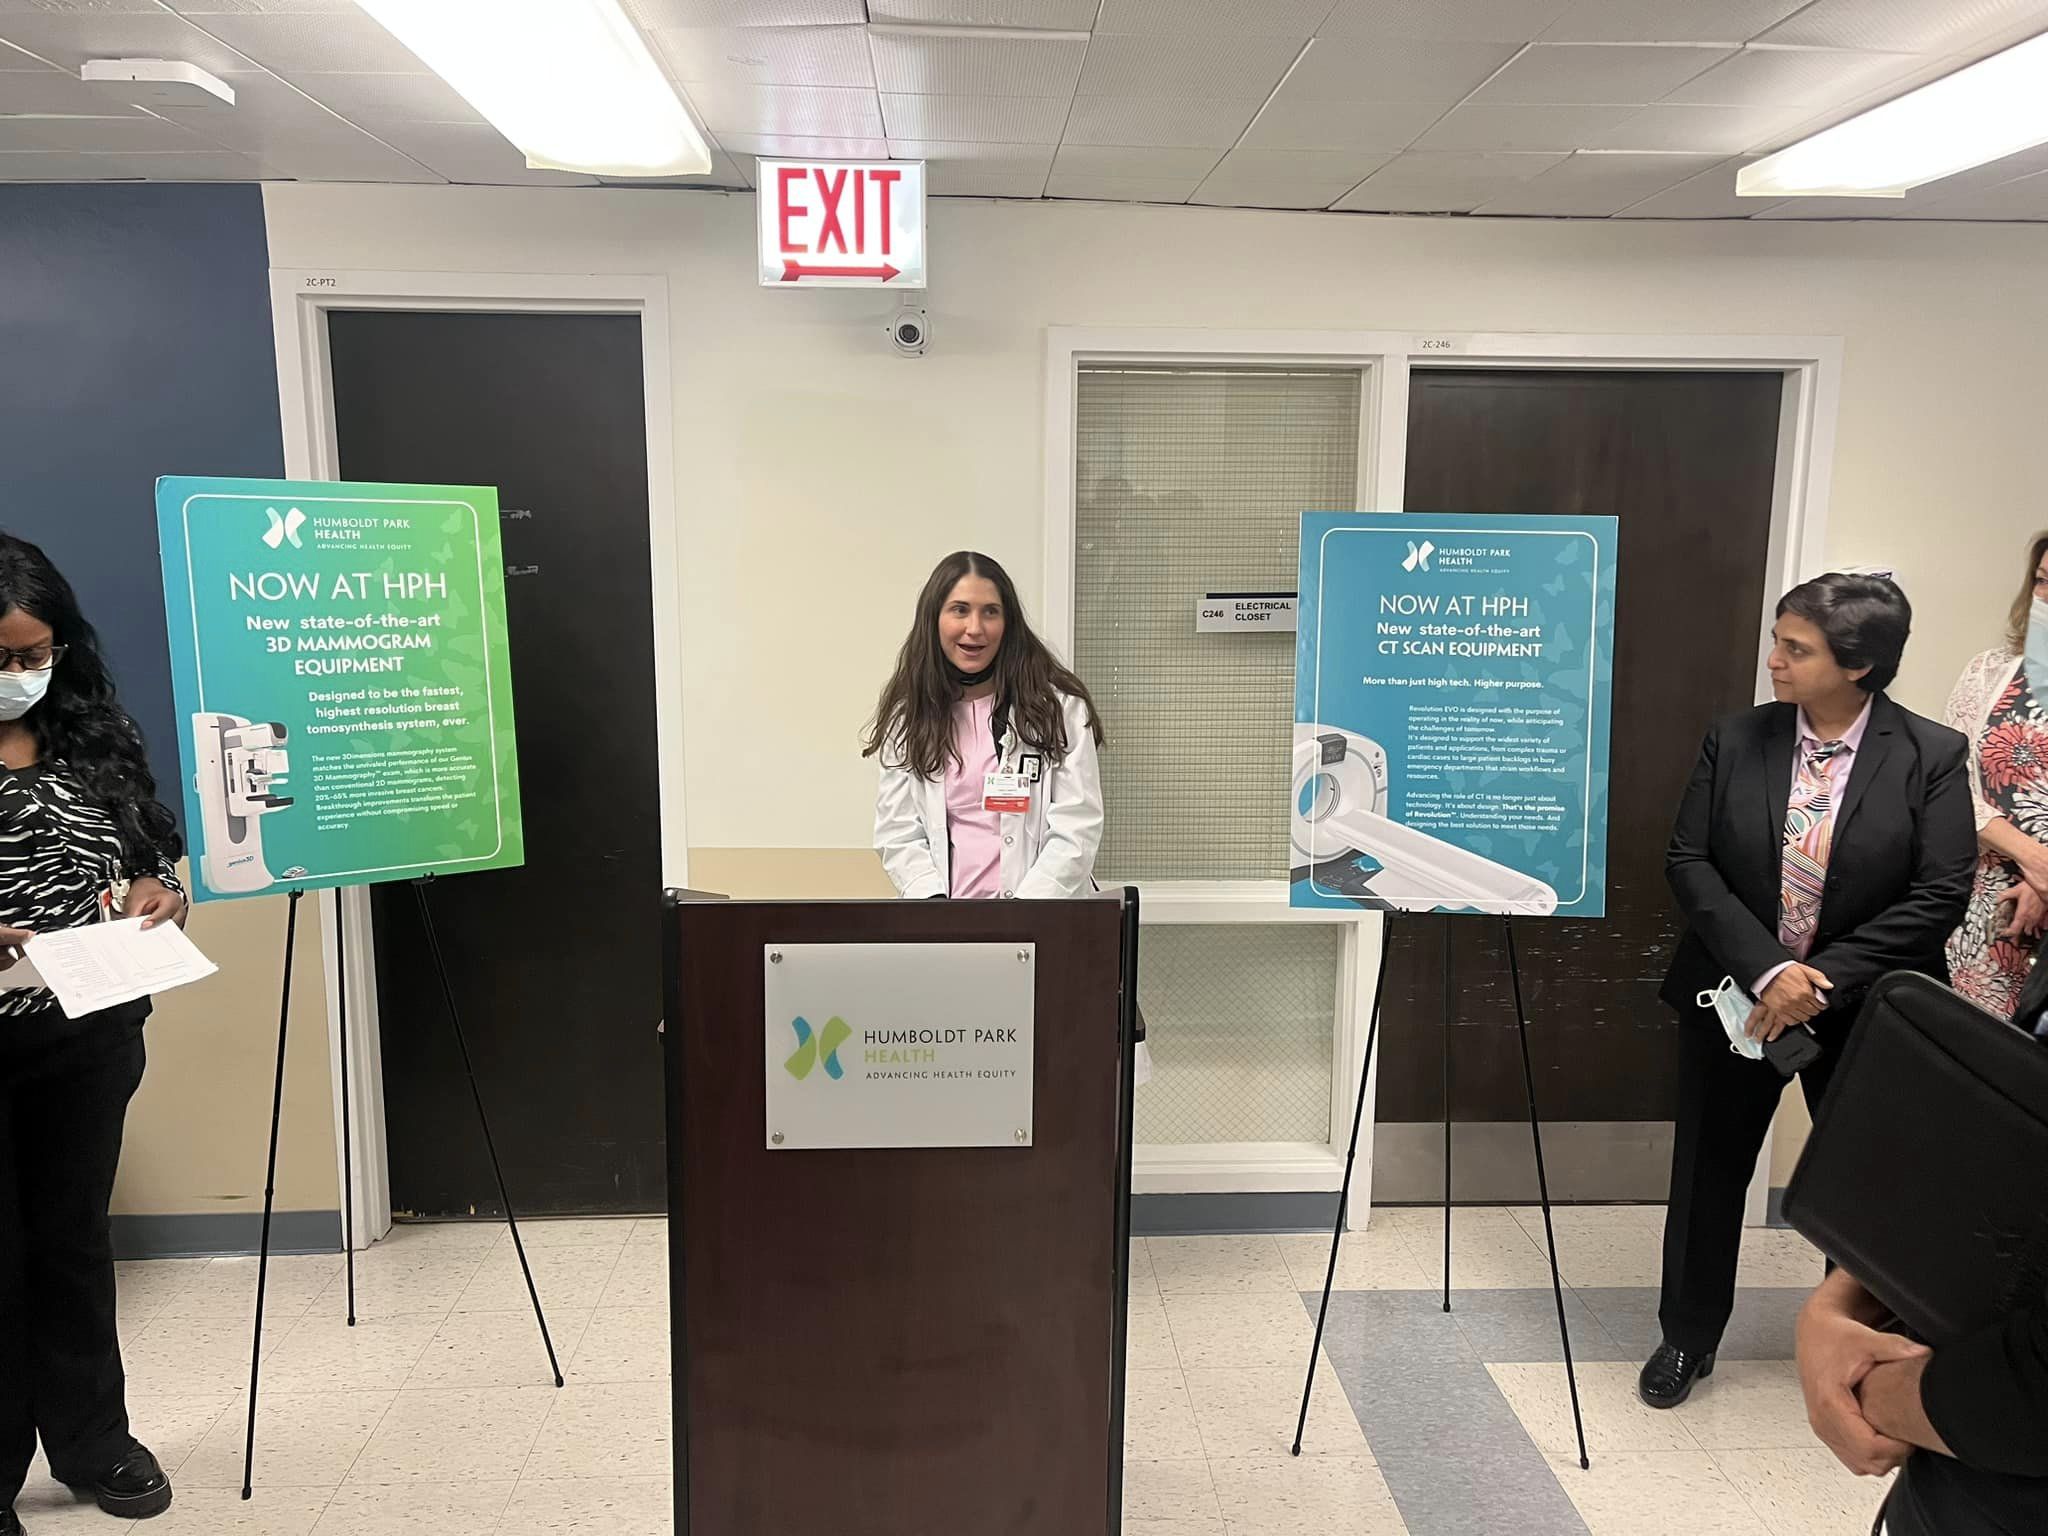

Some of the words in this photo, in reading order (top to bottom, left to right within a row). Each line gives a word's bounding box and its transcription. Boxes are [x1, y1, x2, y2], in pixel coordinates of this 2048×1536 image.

[777, 167, 901, 255] EXIT
[306, 278, 336, 286] 2C-PT2
[314, 517, 378, 528] HUMBOLDT
[383, 519, 410, 529] PARK
[315, 529, 360, 540] HEALTH
[1439, 548, 1487, 557] HUMBOLDT
[1490, 548, 1511, 557] PARK
[1439, 557, 1472, 566] HEALTH
[229, 573, 320, 601] NOW
[332, 573, 372, 600] AT
[383, 573, 447, 599] HPH
[1235, 602, 1291, 610] ELECTRICAL
[1380, 595, 1439, 616] NOW
[1445, 596, 1475, 616] AT
[1482, 596, 1528, 617] HPH
[1202, 610, 1224, 618] C246
[1235, 613, 1271, 621] CLOSET
[247, 615, 289, 631] New
[300, 614, 440, 629] state-of-the-art
[1377, 623, 1411, 635] New
[1420, 624, 1541, 638] state-of-the-art
[266, 637, 291, 653] 3D
[297, 634, 431, 652] MAMMOGRAM
[1378, 641, 1399, 655] CT
[1403, 641, 1445, 656] SCAN
[1449, 643, 1543, 658] EQUIPMENT
[294, 656, 404, 676] EQUIPMENT
[1363, 677, 1386, 686] More
[1388, 677, 1408, 686] than
[1409, 677, 1425, 688] just
[1427, 678, 1448, 689] high
[1449, 678, 1471, 687] tech.
[1474, 679, 1504, 689] Higher
[1505, 681, 1544, 690] purpose.
[308, 690, 365, 704] Designed
[368, 689, 381, 700] to
[384, 688, 398, 699] be
[401, 687, 419, 699] the
[422, 686, 464, 698] fastest,
[316, 705, 361, 719] highest
[364, 702, 422, 715] resolution
[425, 701, 459, 712] breast
[306, 720, 393, 735] tomosynthesis
[396, 718, 439, 732] system,
[442, 717, 470, 727] ever.
[864, 1029, 966, 1044] HUMBOLDT
[974, 1028, 1017, 1043] PARK
[864, 1049, 935, 1064] HEALTH
[866, 1071, 928, 1080] ADVANCING
[933, 1071, 972, 1079] HEALTH
[978, 1070, 1016, 1079] EQUITY
